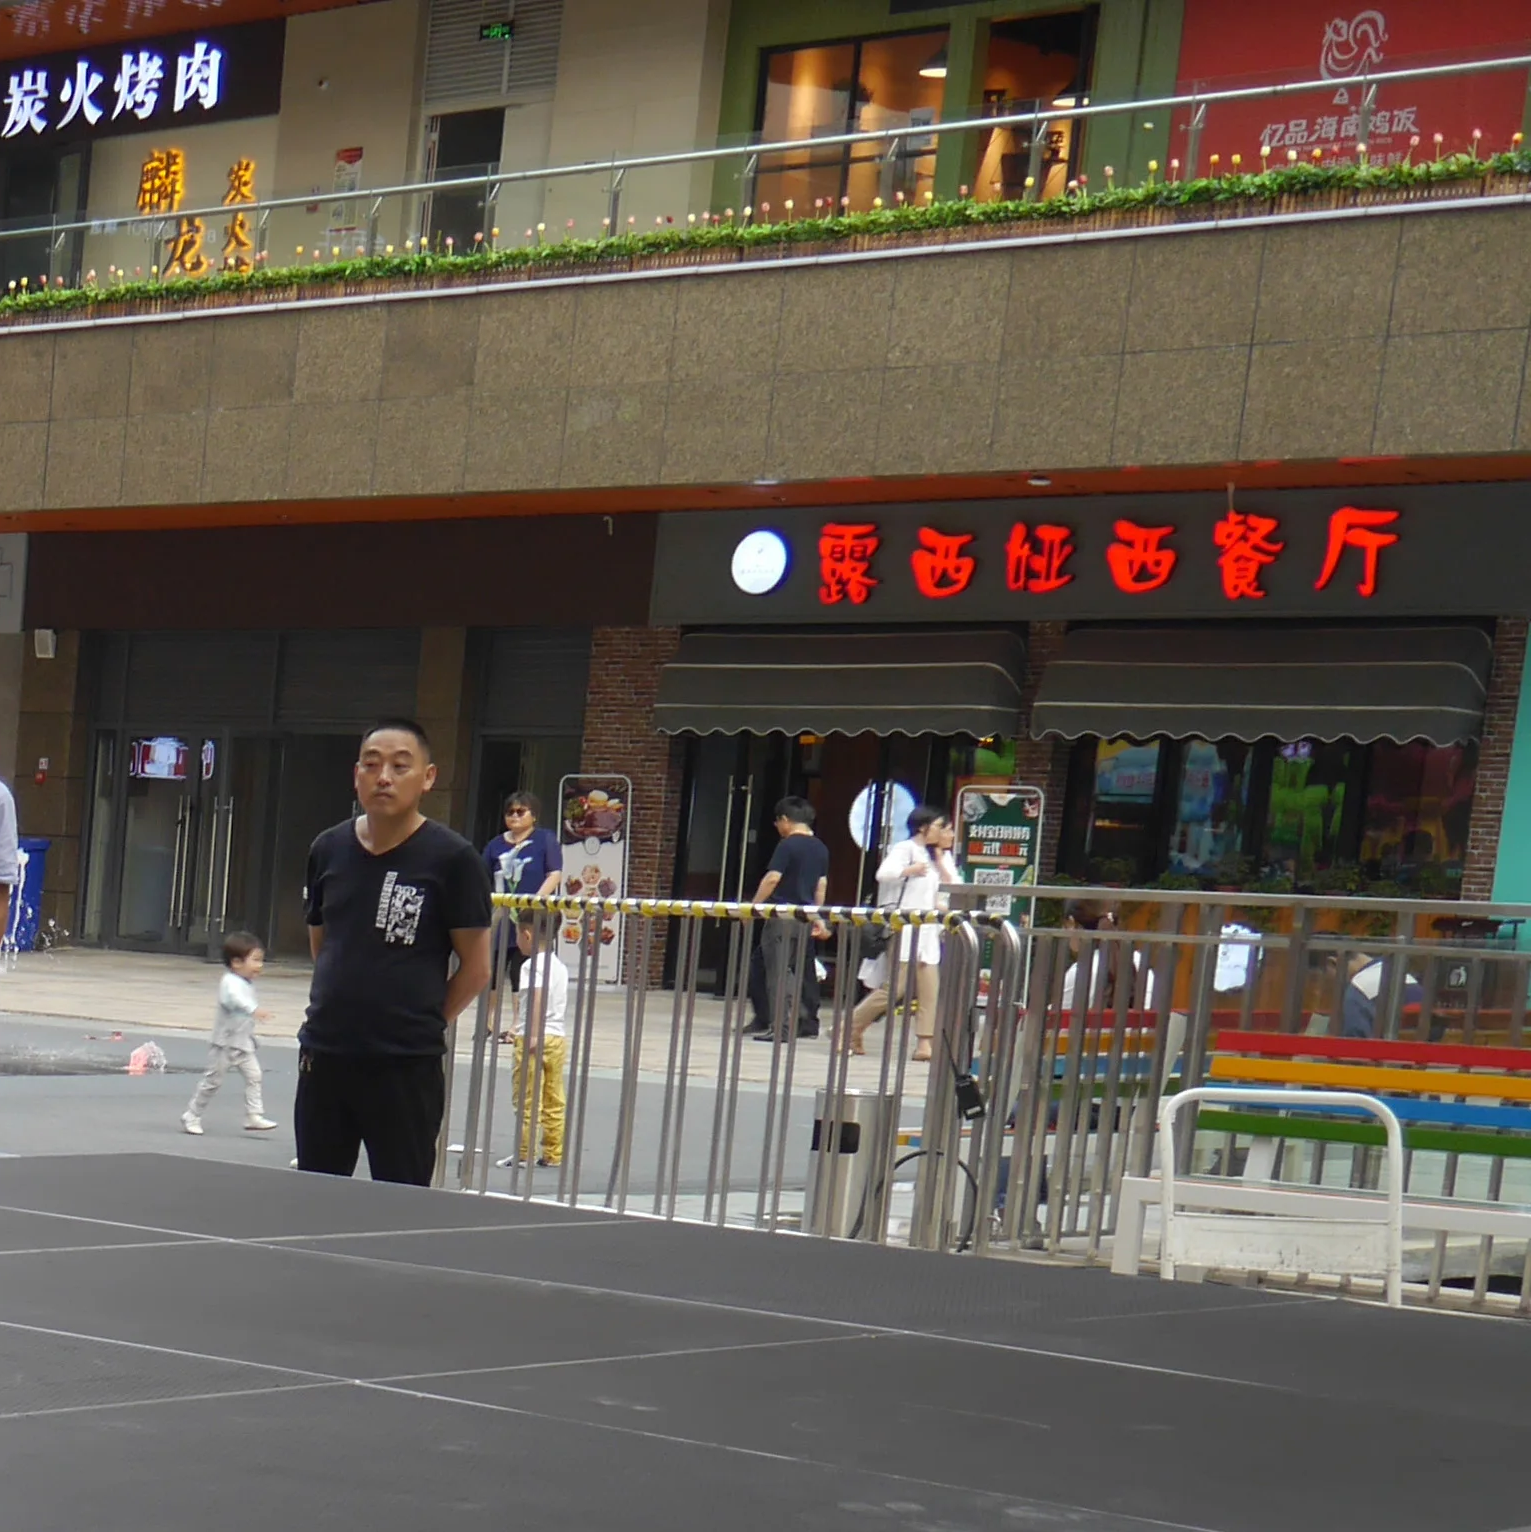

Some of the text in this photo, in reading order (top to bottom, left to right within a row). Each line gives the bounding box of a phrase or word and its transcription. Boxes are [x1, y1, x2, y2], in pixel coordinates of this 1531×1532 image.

[817, 506, 1403, 605] 露西娅西餐厅
